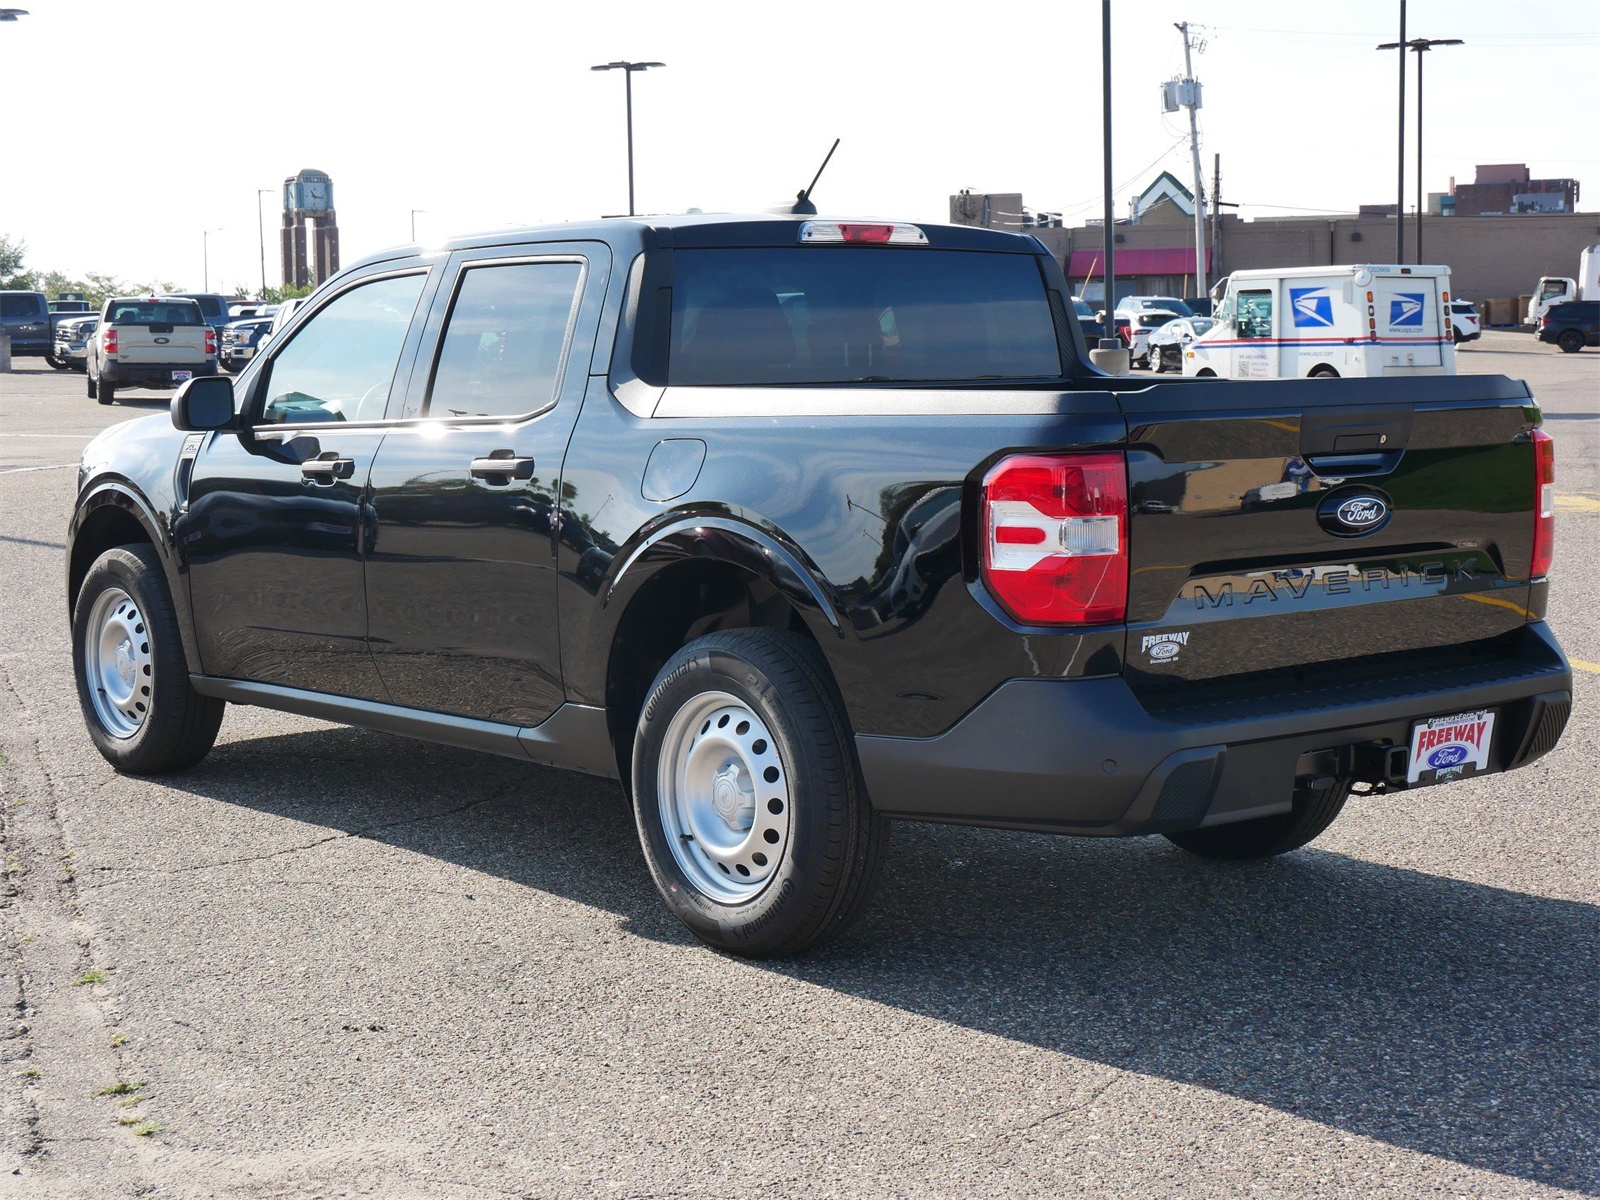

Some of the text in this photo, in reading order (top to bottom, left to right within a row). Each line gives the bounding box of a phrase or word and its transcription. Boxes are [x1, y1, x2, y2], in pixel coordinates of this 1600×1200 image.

[1347, 501, 1378, 521] Ford
[1193, 558, 1480, 610] MAVERICK
[1141, 631, 1190, 653] FREEWAY
[1156, 645, 1175, 656] Ford
[1416, 721, 1487, 763] FREEWAY
[1434, 748, 1461, 765] Ford
